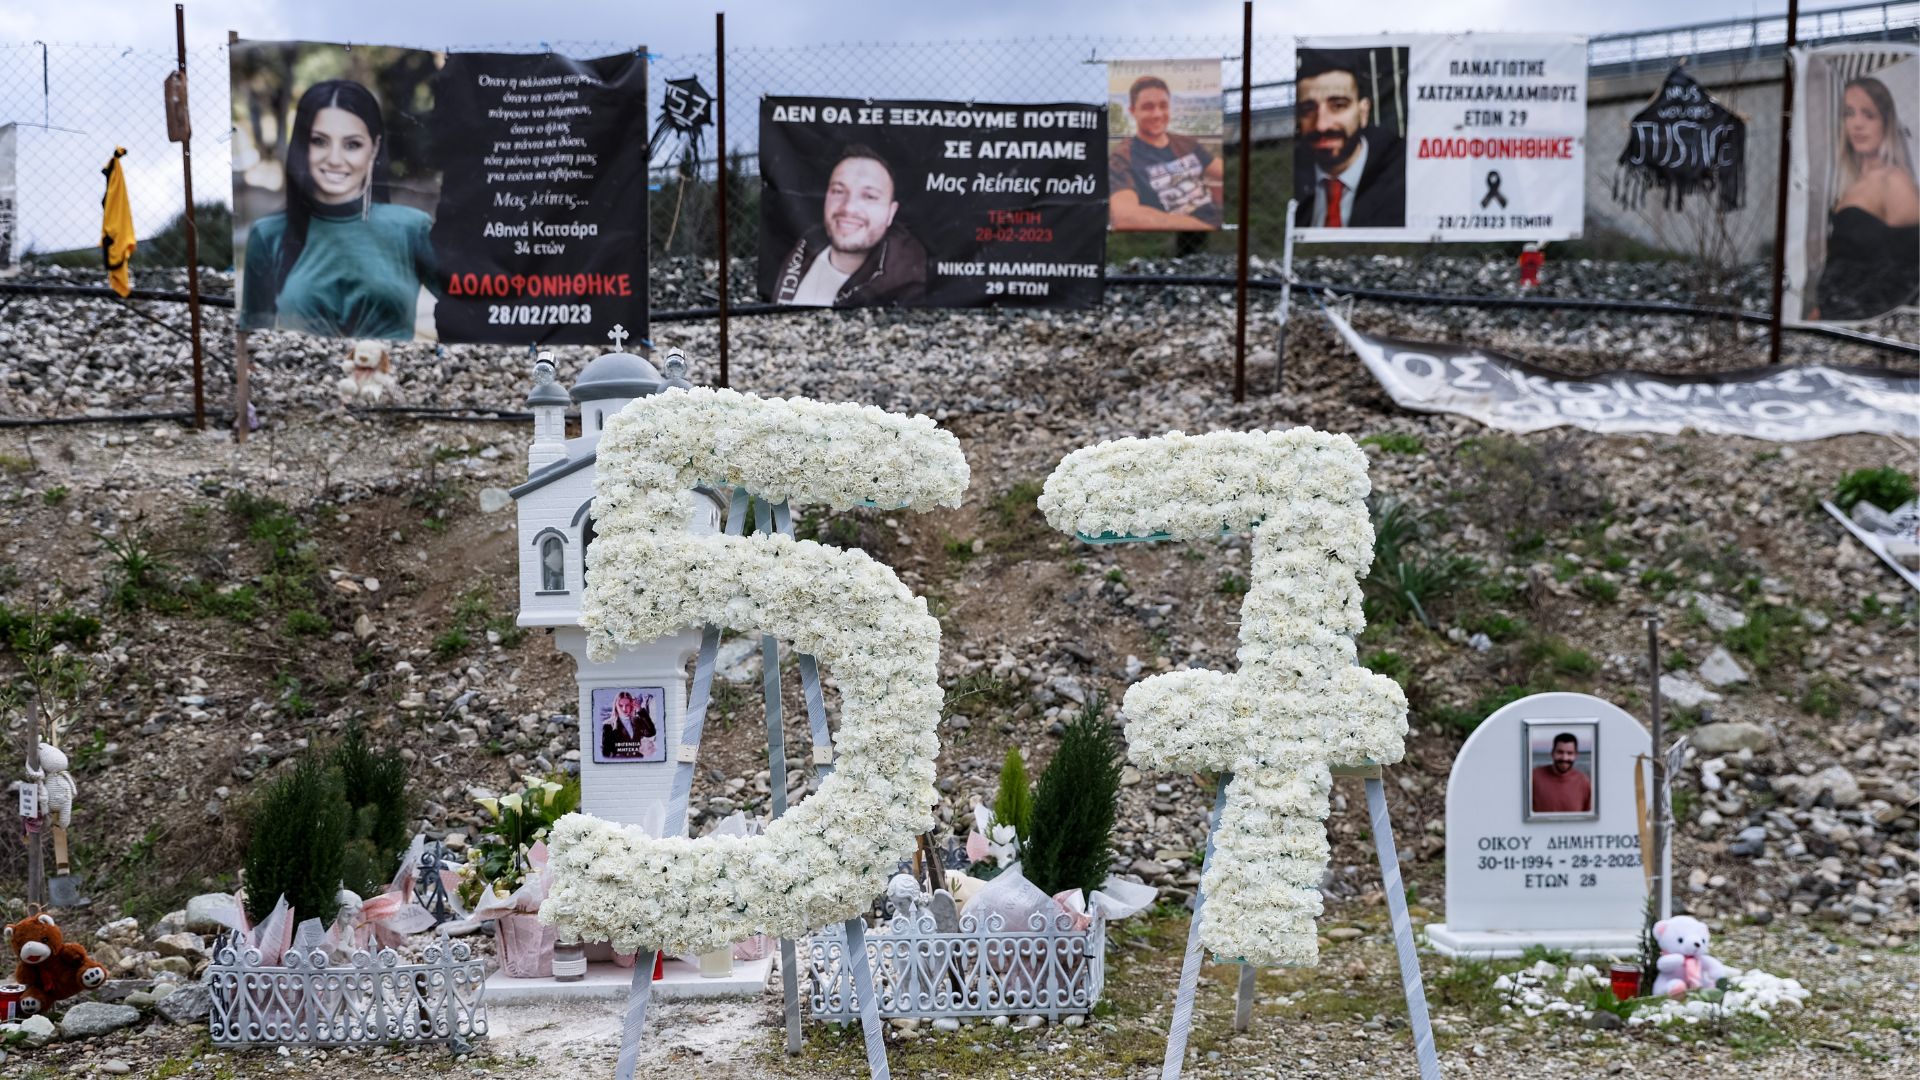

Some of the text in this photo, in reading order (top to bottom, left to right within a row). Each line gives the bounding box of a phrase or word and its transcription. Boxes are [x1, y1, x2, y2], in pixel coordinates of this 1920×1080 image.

[1450, 59, 1545, 76] ΠΑΝΑΓΙΩΤΗΣ
[1417, 84, 1578, 101] ΧΑΤΖΗΧΑΡΑΛΑΜΠΟΥΣ
[772, 105, 1098, 129] ΔΕΝ ΘΑ ΣΕ ΞΕΧΑΣΟΥΜΕ ΠΟΤΕ!!!
[1464, 110, 1528, 126] ΕΤΩΝ 29
[944, 140, 1087, 160] ΣΕ ΑΓΑΠΑΜΕ
[1417, 137, 1575, 159] ΔΟΛΟΦΟΝΗΘΗΚΕ
[926, 172, 1097, 196] Μας λείπεις πολύ
[493, 190, 589, 211] Μας λείπεις...
[987, 209, 1042, 225] ΤΕΜΠΗ
[1438, 215, 1553, 229] 28/2/2023 ΤΕΜΠΗ
[483, 221, 598, 240] Αθηνά Κατσάρα
[975, 227, 1053, 242] 28-02-2023
[514, 240, 565, 254] 34 ετών
[937, 261, 1098, 278] ΝΙΚΟΣ ΝΑΛΜΠΑΝΤΗΣ
[448, 272, 632, 297] ΔΟΛΟΦΟΝΗΘΗΚΕ
[985, 281, 1049, 295] 29 ΕΤΩΝ
[488, 304, 592, 325] 28/02/2023
[537, 387, 1409, 968] 57
[1478, 835, 1641, 851] ΟΙΚΟΥ ΔΗΜΗΤΡΙΟΣ
[1478, 855, 1553, 870] 30-11-1994
[1571, 854, 1643, 869] 28-2-2023
[1525, 873, 1598, 888] ΕΤΩΝ 28
